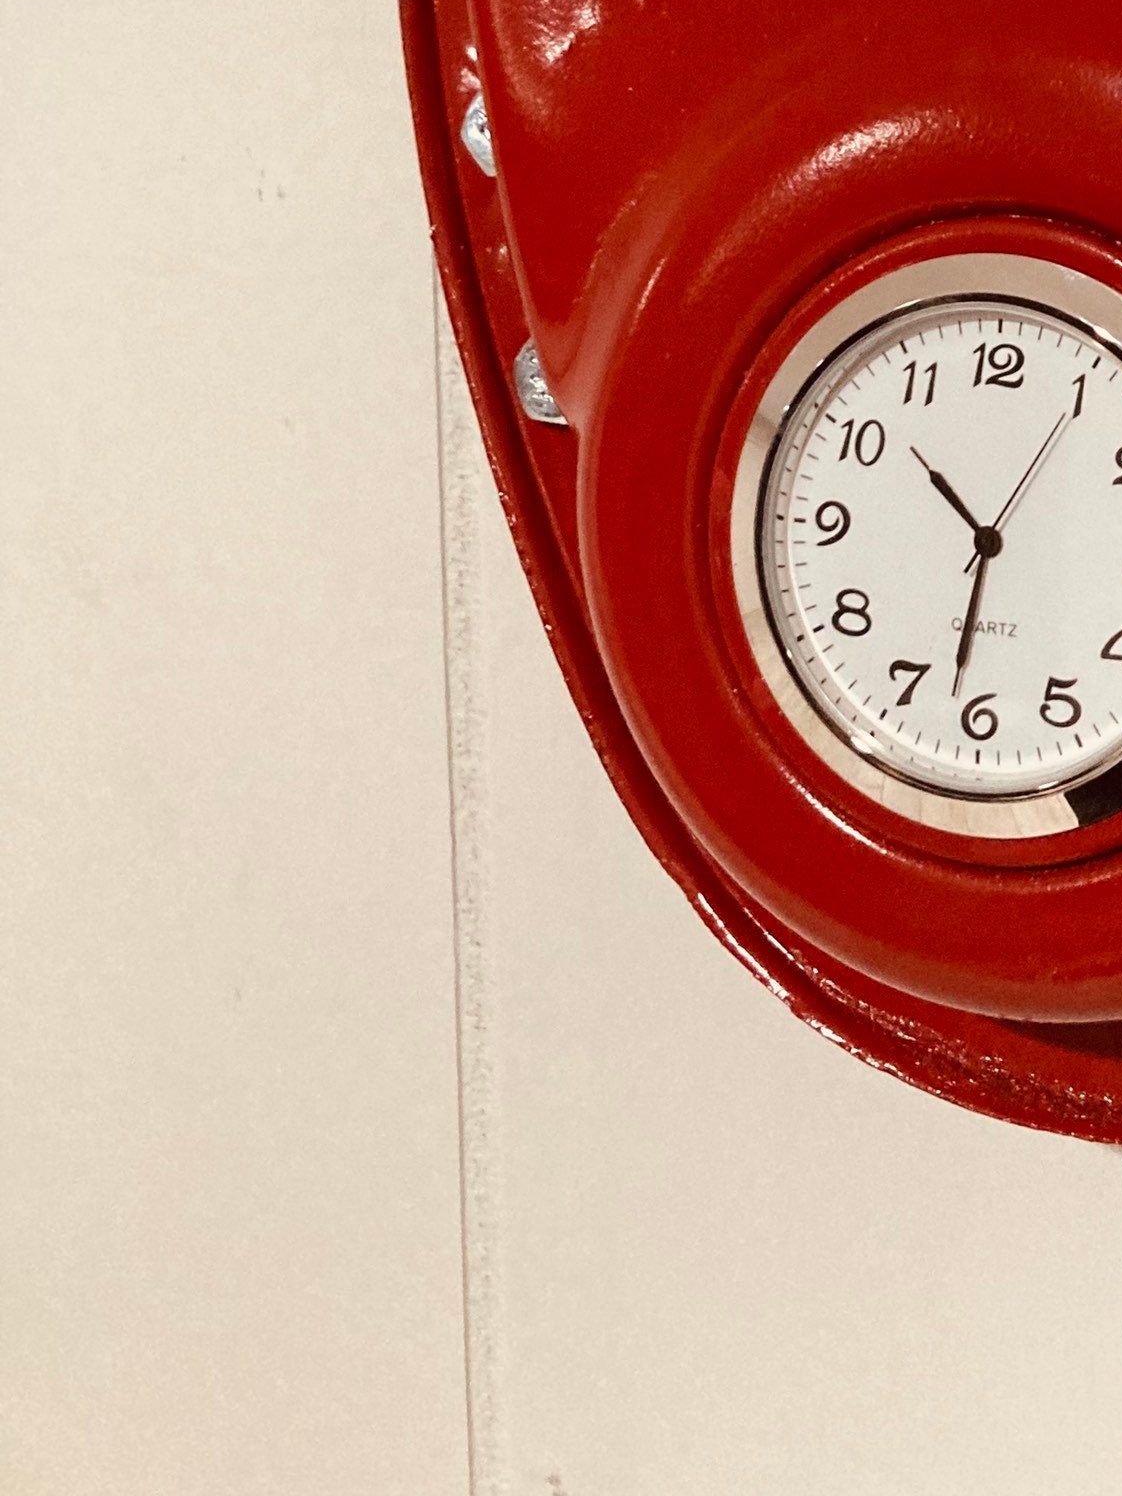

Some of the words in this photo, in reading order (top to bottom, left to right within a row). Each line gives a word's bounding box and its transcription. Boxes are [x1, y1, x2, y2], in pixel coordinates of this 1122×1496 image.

[903, 360, 938, 407] 11
[973, 342, 1025, 389] 12
[1071, 373, 1087, 419] 1
[838, 418, 886, 467] 10
[814, 500, 851, 547] 9
[831, 588, 872, 637] 8
[951, 617, 1018, 638] QARTZ
[888, 659, 932, 707] 7
[1039, 677, 1082, 728] 5
[960, 693, 998, 742] 6
